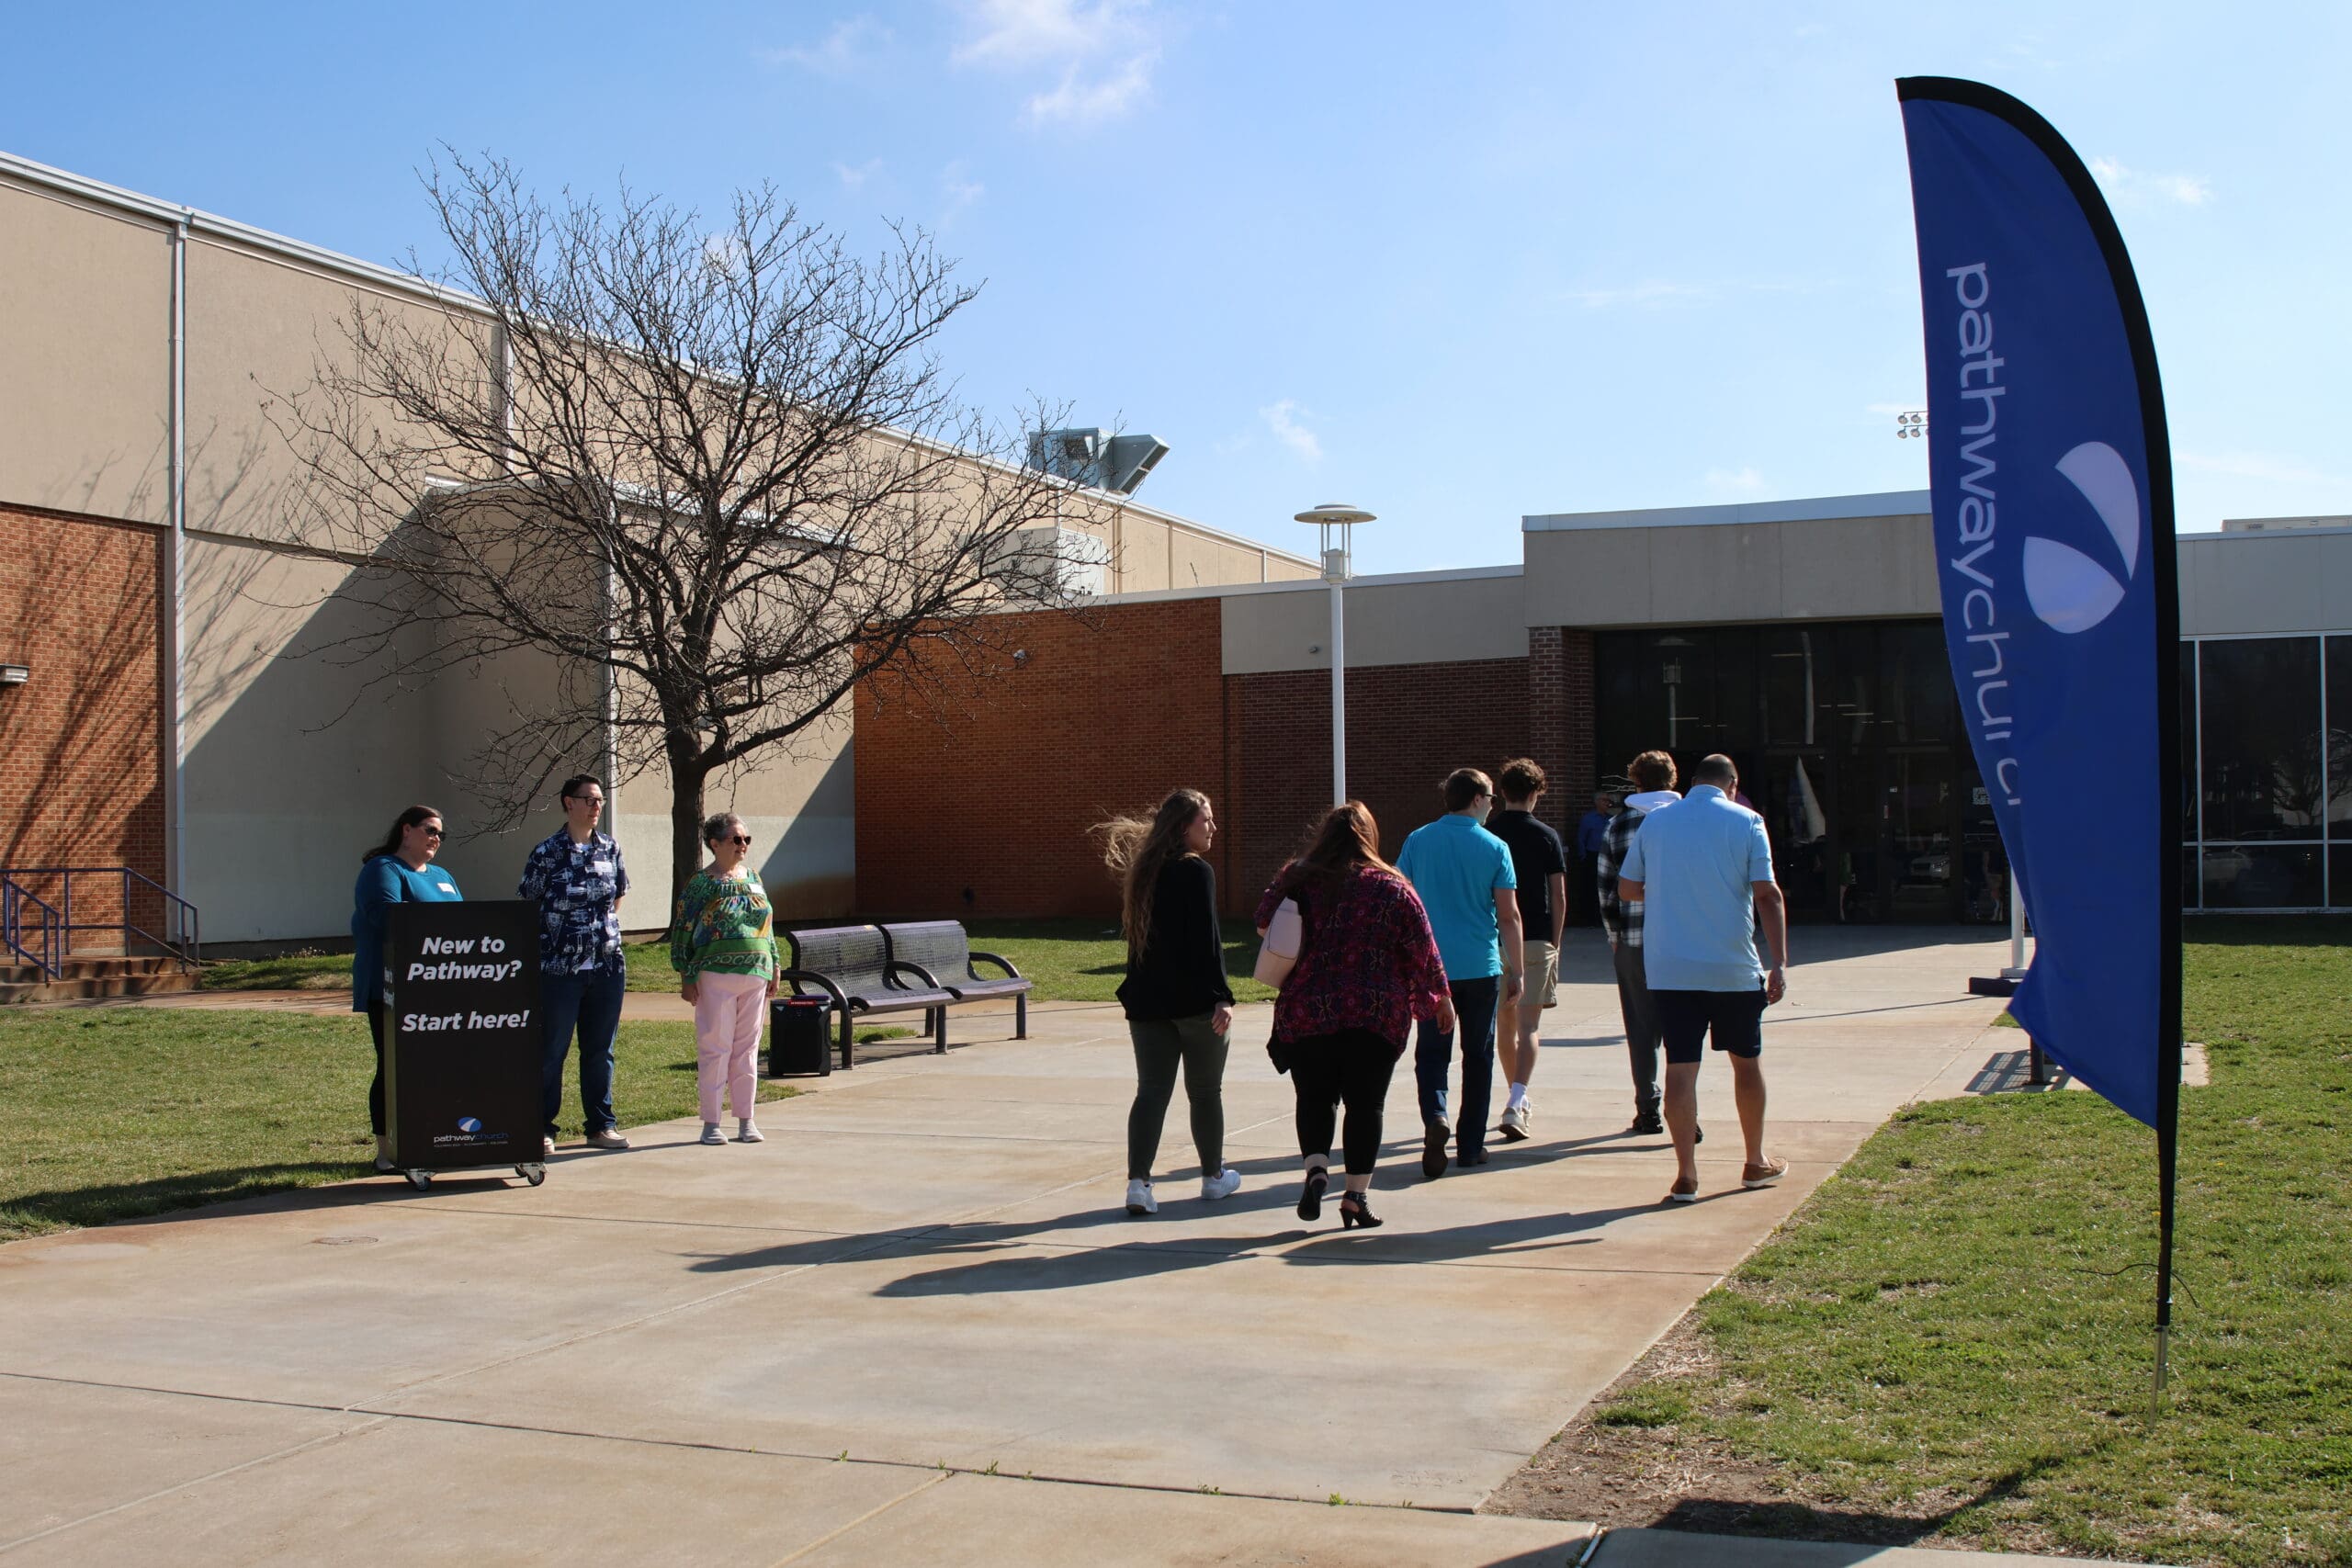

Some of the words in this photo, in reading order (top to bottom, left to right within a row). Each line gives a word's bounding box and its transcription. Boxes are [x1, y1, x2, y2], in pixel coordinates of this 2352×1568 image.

[421, 936, 474, 955] New
[481, 935, 505, 954] to
[406, 960, 523, 983] Pathway?
[401, 1012, 462, 1032] Start
[467, 1010, 530, 1031] here!
